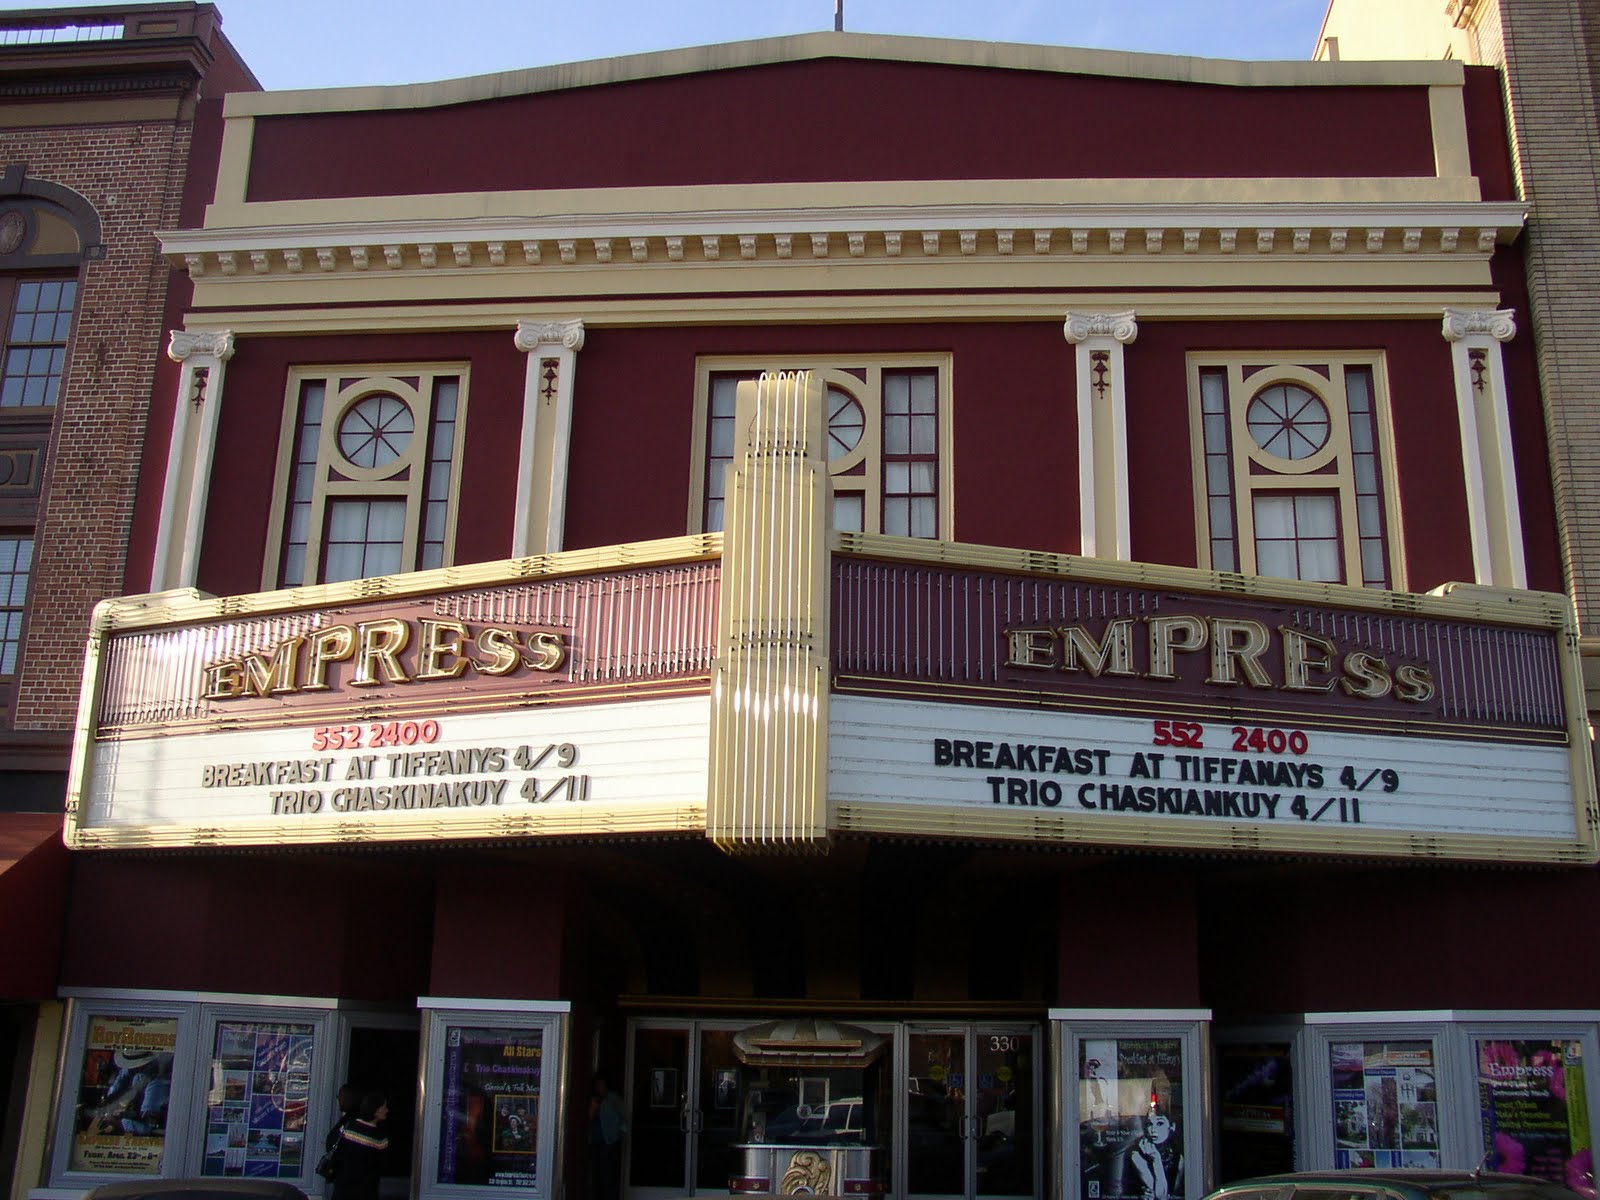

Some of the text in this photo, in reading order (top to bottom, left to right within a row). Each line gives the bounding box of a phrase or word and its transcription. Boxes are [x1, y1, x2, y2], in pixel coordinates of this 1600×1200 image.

[202, 616, 565, 701] EMPRESS
[1003, 615, 1435, 702] EMPRESS
[312, 720, 439, 751] 552 2400
[1153, 720, 1308, 755] 552 2400
[202, 742, 577, 788] BREAKFAST AT TIFFANYS 4/9
[934, 738, 1399, 793] BREAKFAST AT TIFFANAYS 4/9
[269, 775, 588, 815] TRIO CHASKINAKUY 4/11
[987, 776, 1361, 823] TRIO CHASKIANKUY 4/11
[503, 1046, 541, 1058] All Stars
[990, 1035, 1020, 1052] 330
[1489, 1063, 1554, 1079] Empress
